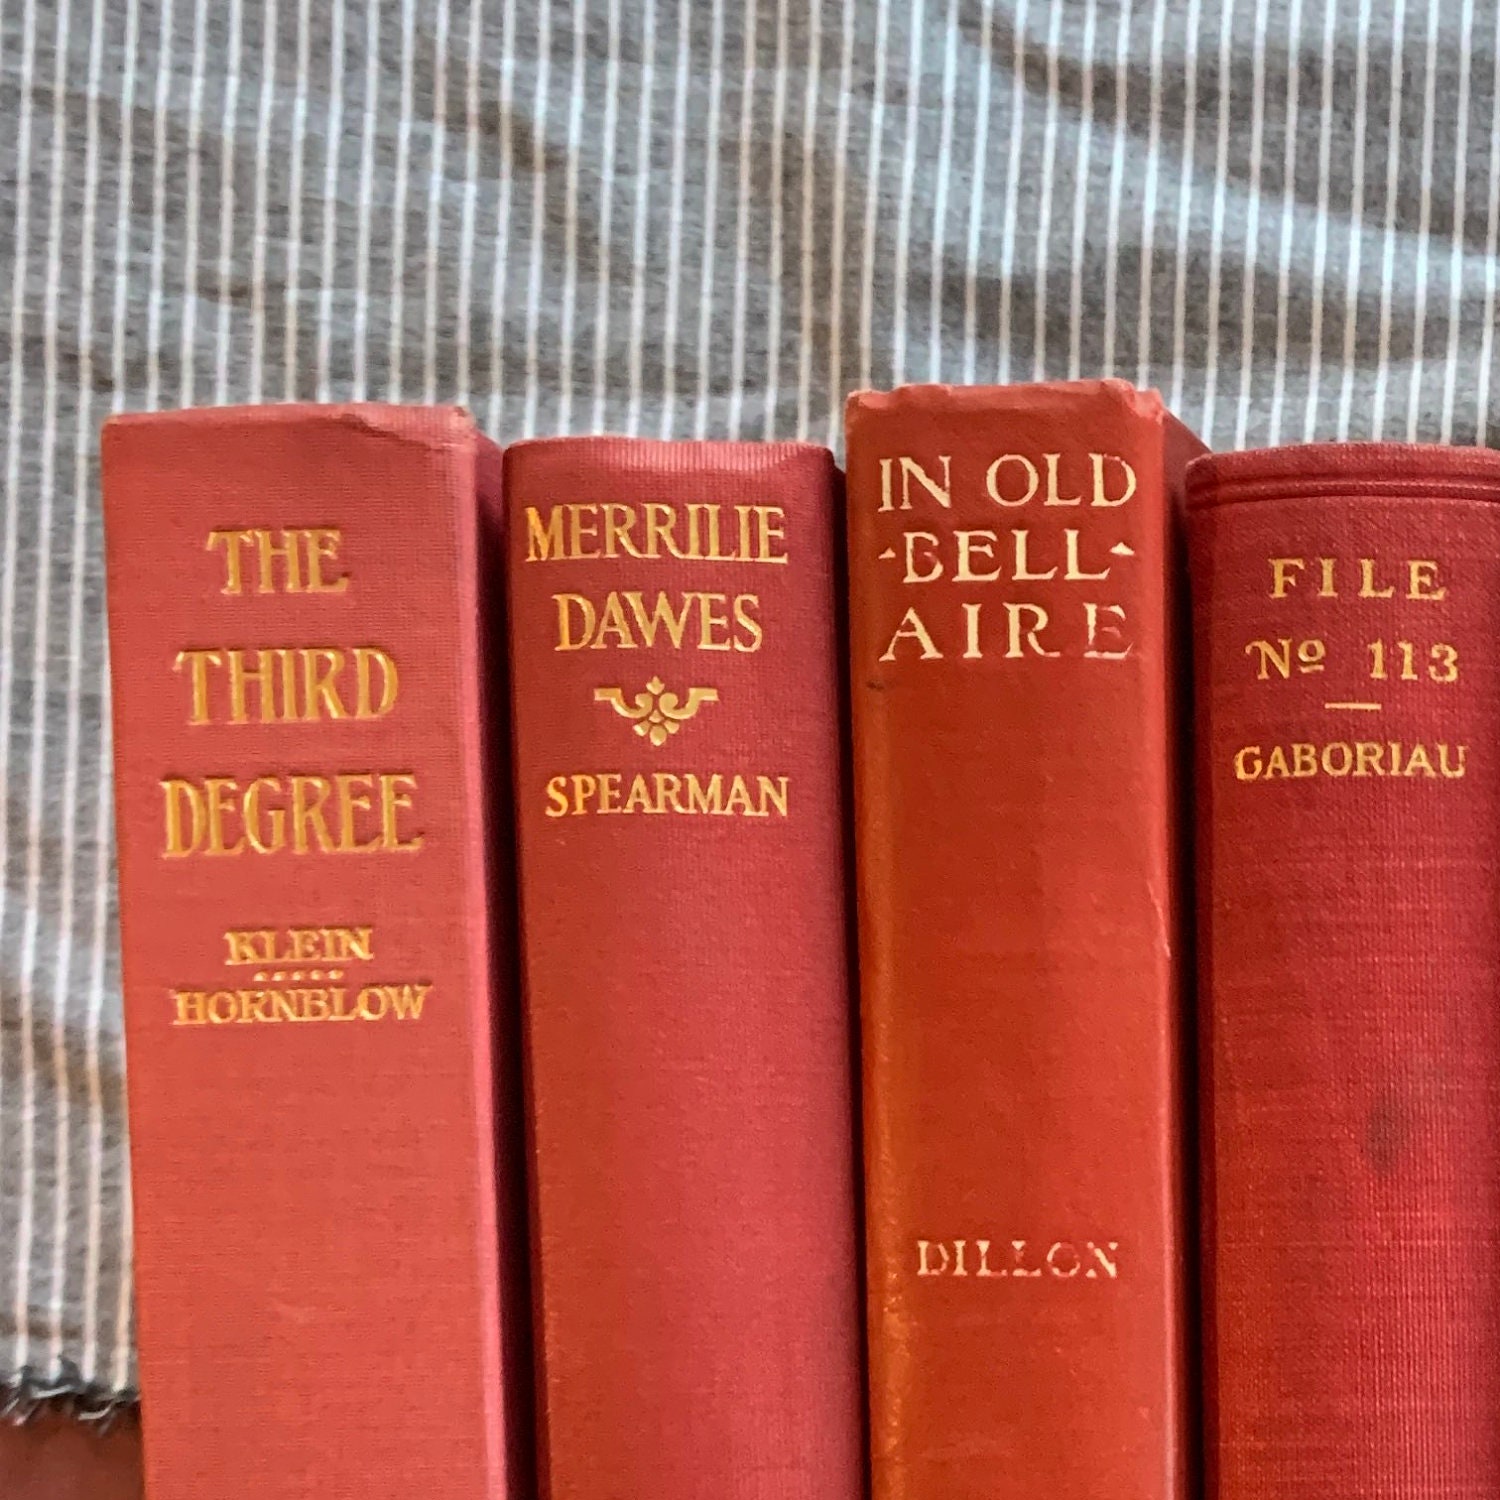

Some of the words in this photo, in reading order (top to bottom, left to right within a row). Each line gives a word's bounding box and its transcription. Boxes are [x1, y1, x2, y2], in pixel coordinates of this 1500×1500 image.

[878, 454, 951, 512] IN
[986, 453, 1137, 507] OLD
[525, 503, 788, 565] MERRILIE
[207, 529, 349, 594] THE
[1269, 558, 1446, 600] FILE
[554, 592, 763, 653] DAWES
[879, 602, 1133, 661] AIRE
[1368, 638, 1459, 682] 113
[172, 648, 399, 726] THIRD
[1234, 741, 1469, 780] GABORIAU
[162, 772, 424, 858] DEGREE
[546, 775, 789, 818] SPEARMAN
[224, 927, 374, 965] KLEIN
[170, 983, 432, 1025] HORNBLOW
[917, 1240, 1118, 1278] DILLON
